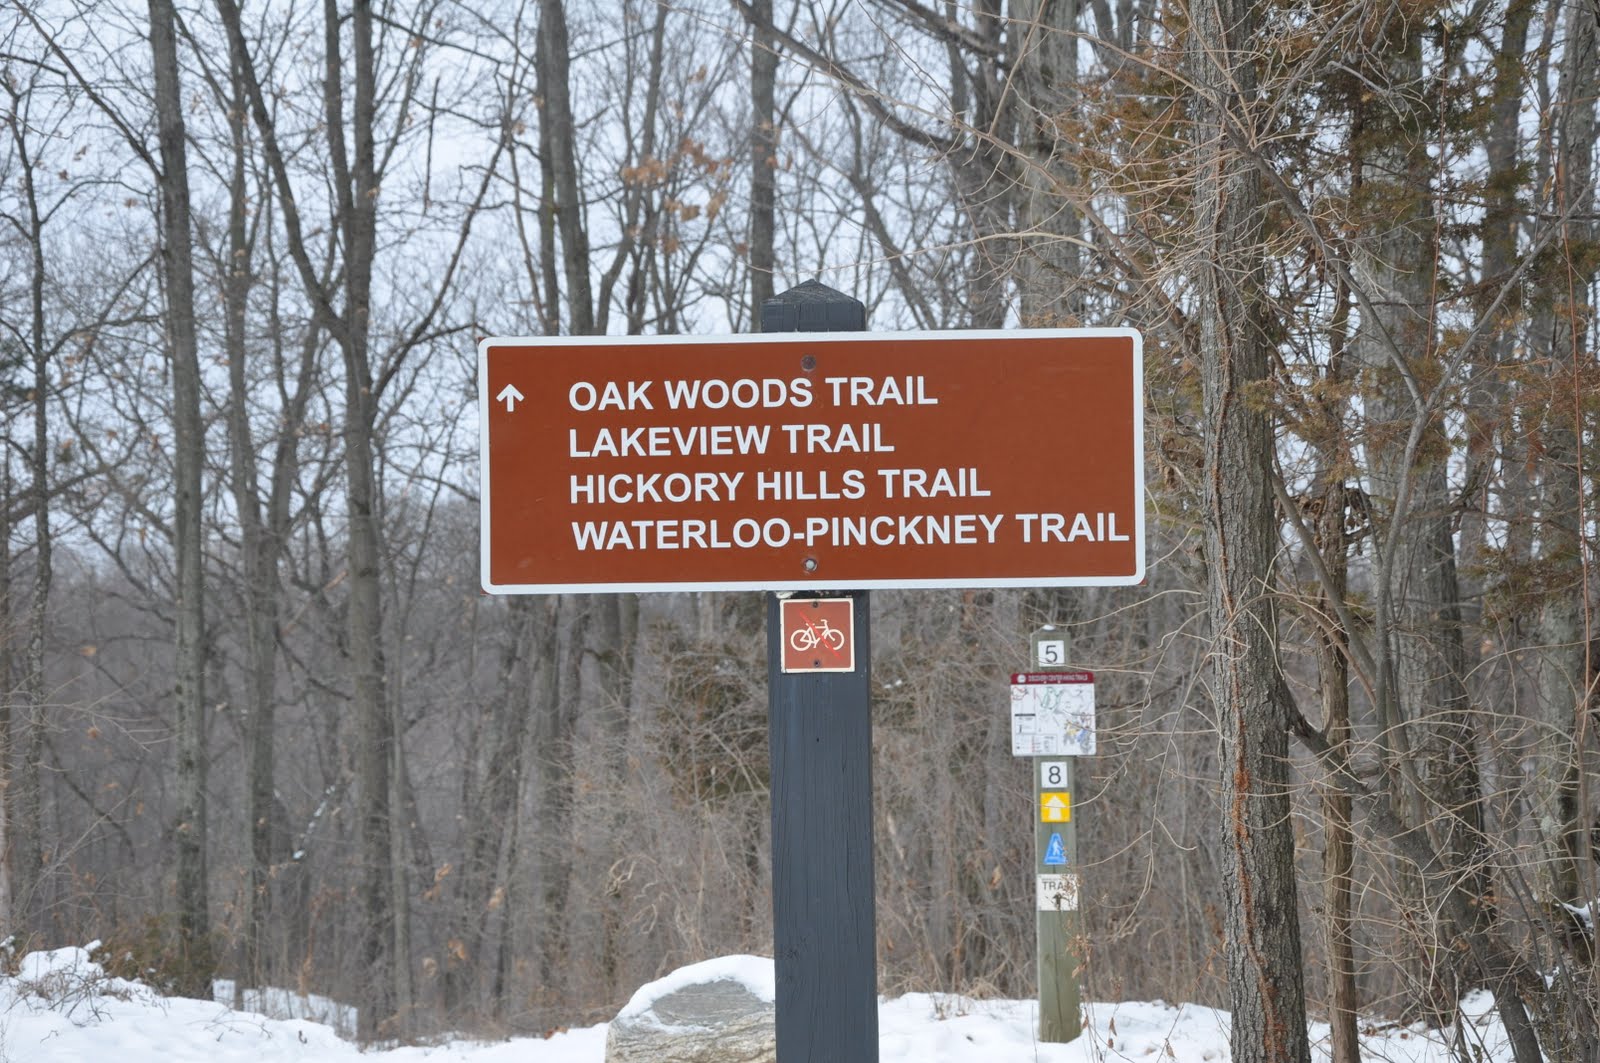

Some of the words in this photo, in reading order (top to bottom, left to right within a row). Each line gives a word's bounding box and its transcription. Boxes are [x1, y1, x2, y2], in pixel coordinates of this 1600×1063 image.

[568, 380, 653, 411] OAK
[663, 377, 813, 410] WOODS
[824, 375, 939, 407] TRAIL
[569, 424, 771, 458] LAKEVIEW
[781, 423, 895, 454] TRAIL
[570, 471, 745, 504] HICKORY
[757, 469, 866, 501] HILLS
[877, 467, 992, 499] TRAIL
[571, 514, 1004, 551] WATERLOO-PINCKNEY
[1015, 512, 1130, 543] TRAIL
[1045, 644, 1058, 664] 5
[1048, 765, 1061, 784] 8
